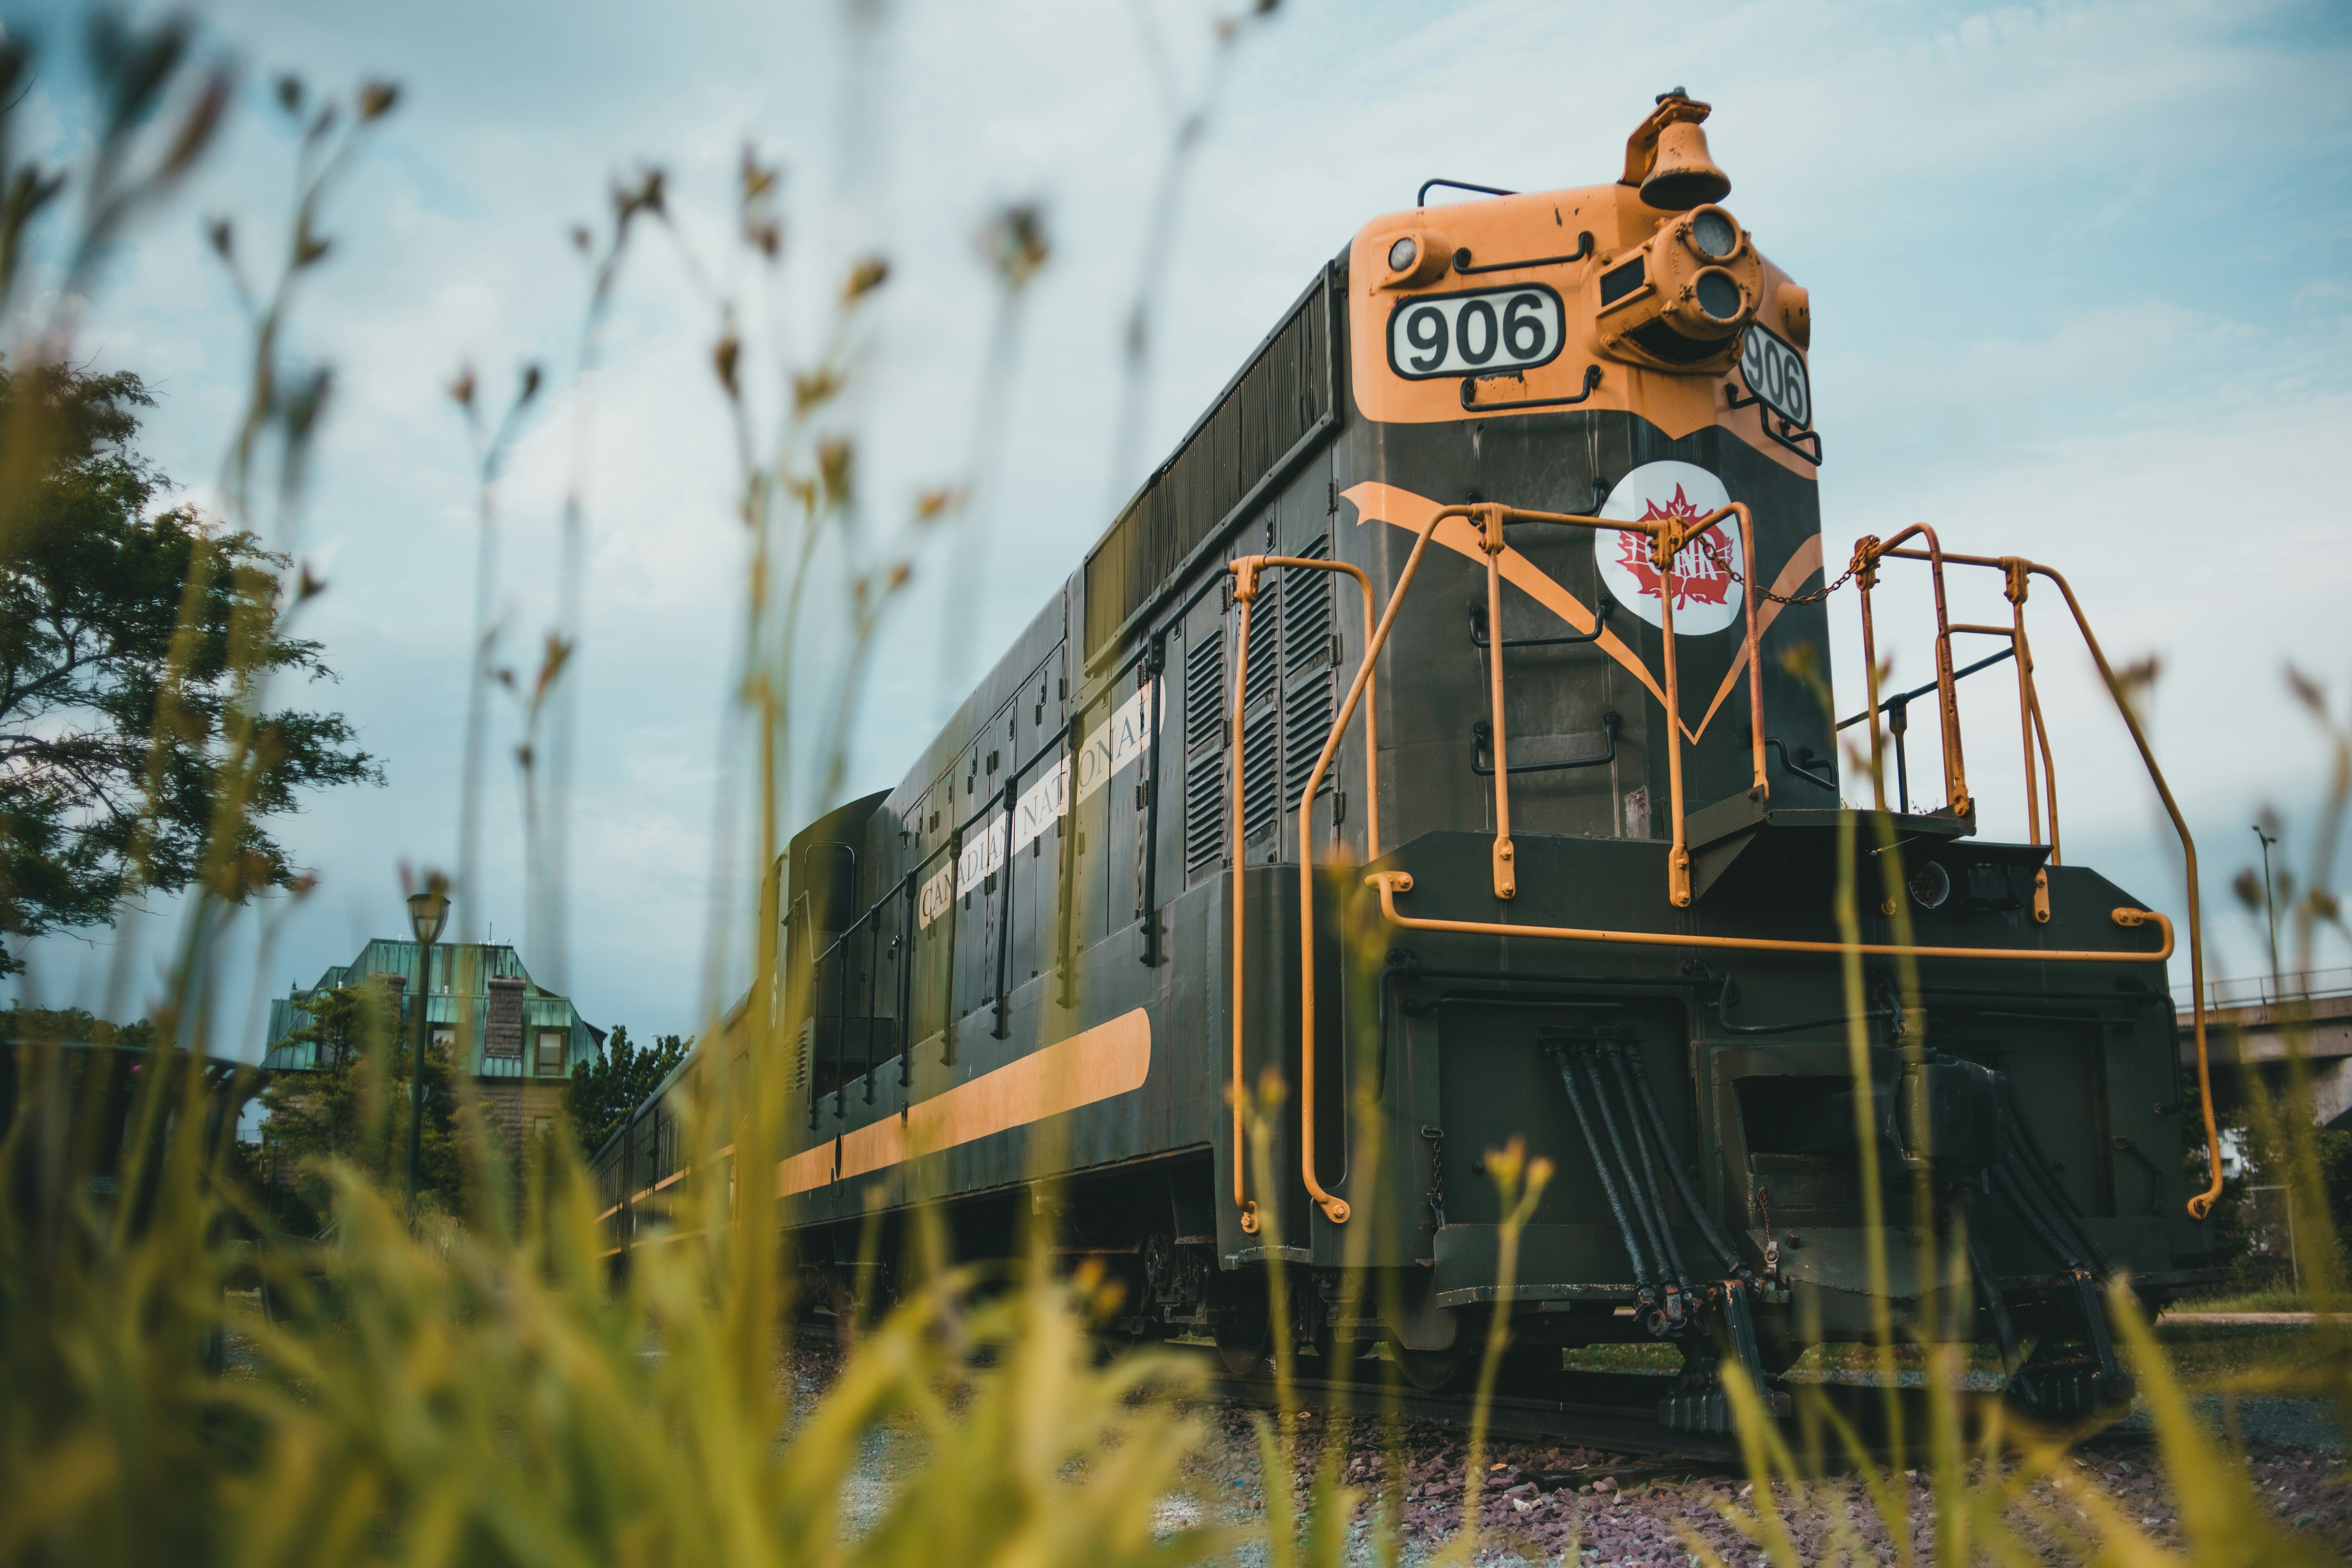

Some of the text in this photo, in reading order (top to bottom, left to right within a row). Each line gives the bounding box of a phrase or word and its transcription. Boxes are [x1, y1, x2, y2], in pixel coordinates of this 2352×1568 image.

[1407, 293, 1546, 371] 906
[1744, 327, 1803, 419] 906
[1022, 697, 1152, 837] NATONAL
